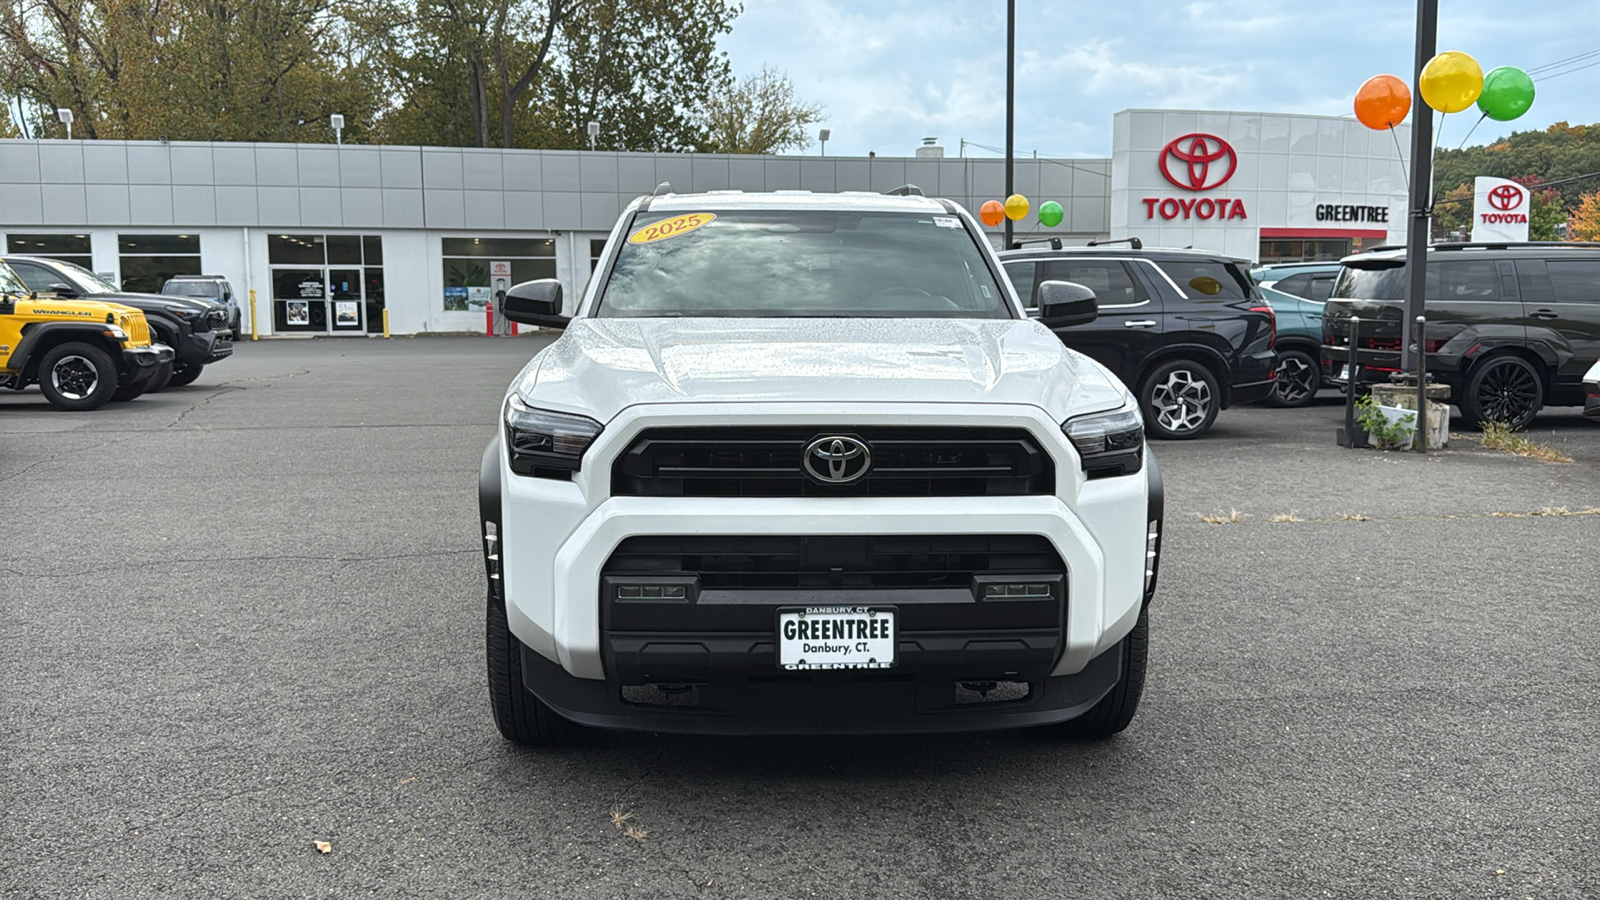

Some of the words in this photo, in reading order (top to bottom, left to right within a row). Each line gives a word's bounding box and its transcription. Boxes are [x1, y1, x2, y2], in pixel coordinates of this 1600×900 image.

[1142, 198, 1247, 220] TOYOTA
[1316, 204, 1389, 223] GREENTREE
[1480, 213, 1528, 224] TOYOTA
[645, 215, 701, 240] 2025
[806, 607, 853, 615] DANBURY,
[856, 606, 870, 614] CT
[783, 619, 890, 641] GREENTREE
[803, 642, 852, 656] Danbury,
[855, 642, 870, 653] CT.
[784, 662, 892, 670] GREENTREE
